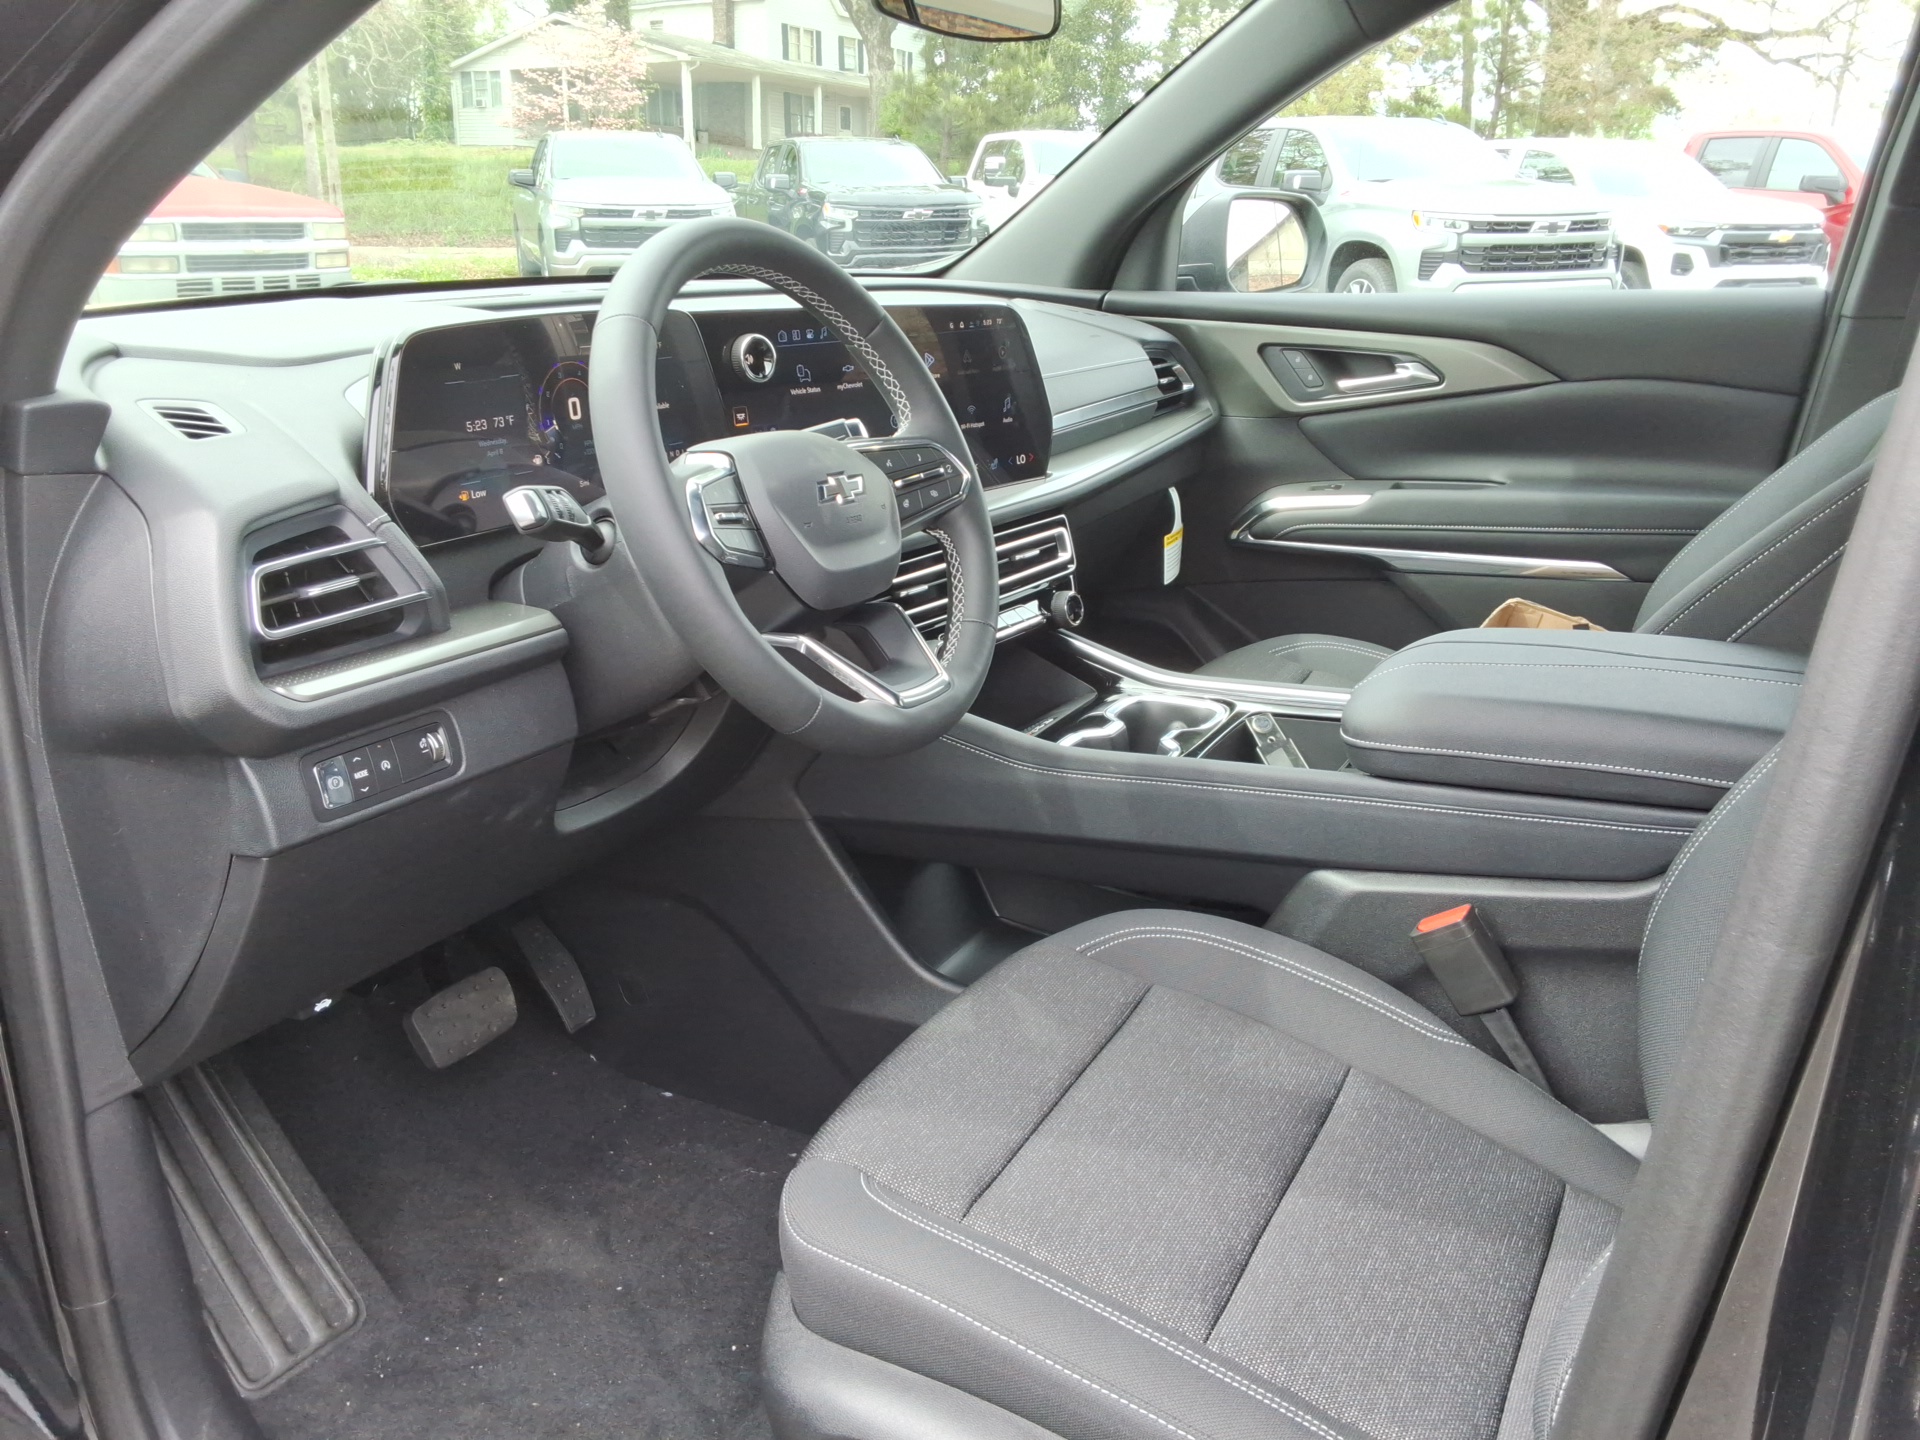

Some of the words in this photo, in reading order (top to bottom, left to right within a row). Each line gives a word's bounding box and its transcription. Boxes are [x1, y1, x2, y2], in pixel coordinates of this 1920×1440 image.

[453, 362, 461, 370] W
[789, 387, 807, 395] Vehicle
[806, 386, 821, 394] Status
[836, 381, 863, 391] myChevrolet
[567, 396, 582, 420] 0
[466, 419, 488, 433] 5:23
[478, 438, 507, 448] Wednesday
[1015, 453, 1027, 465] LO
[470, 489, 487, 499] Low
[353, 768, 370, 780] MODE
